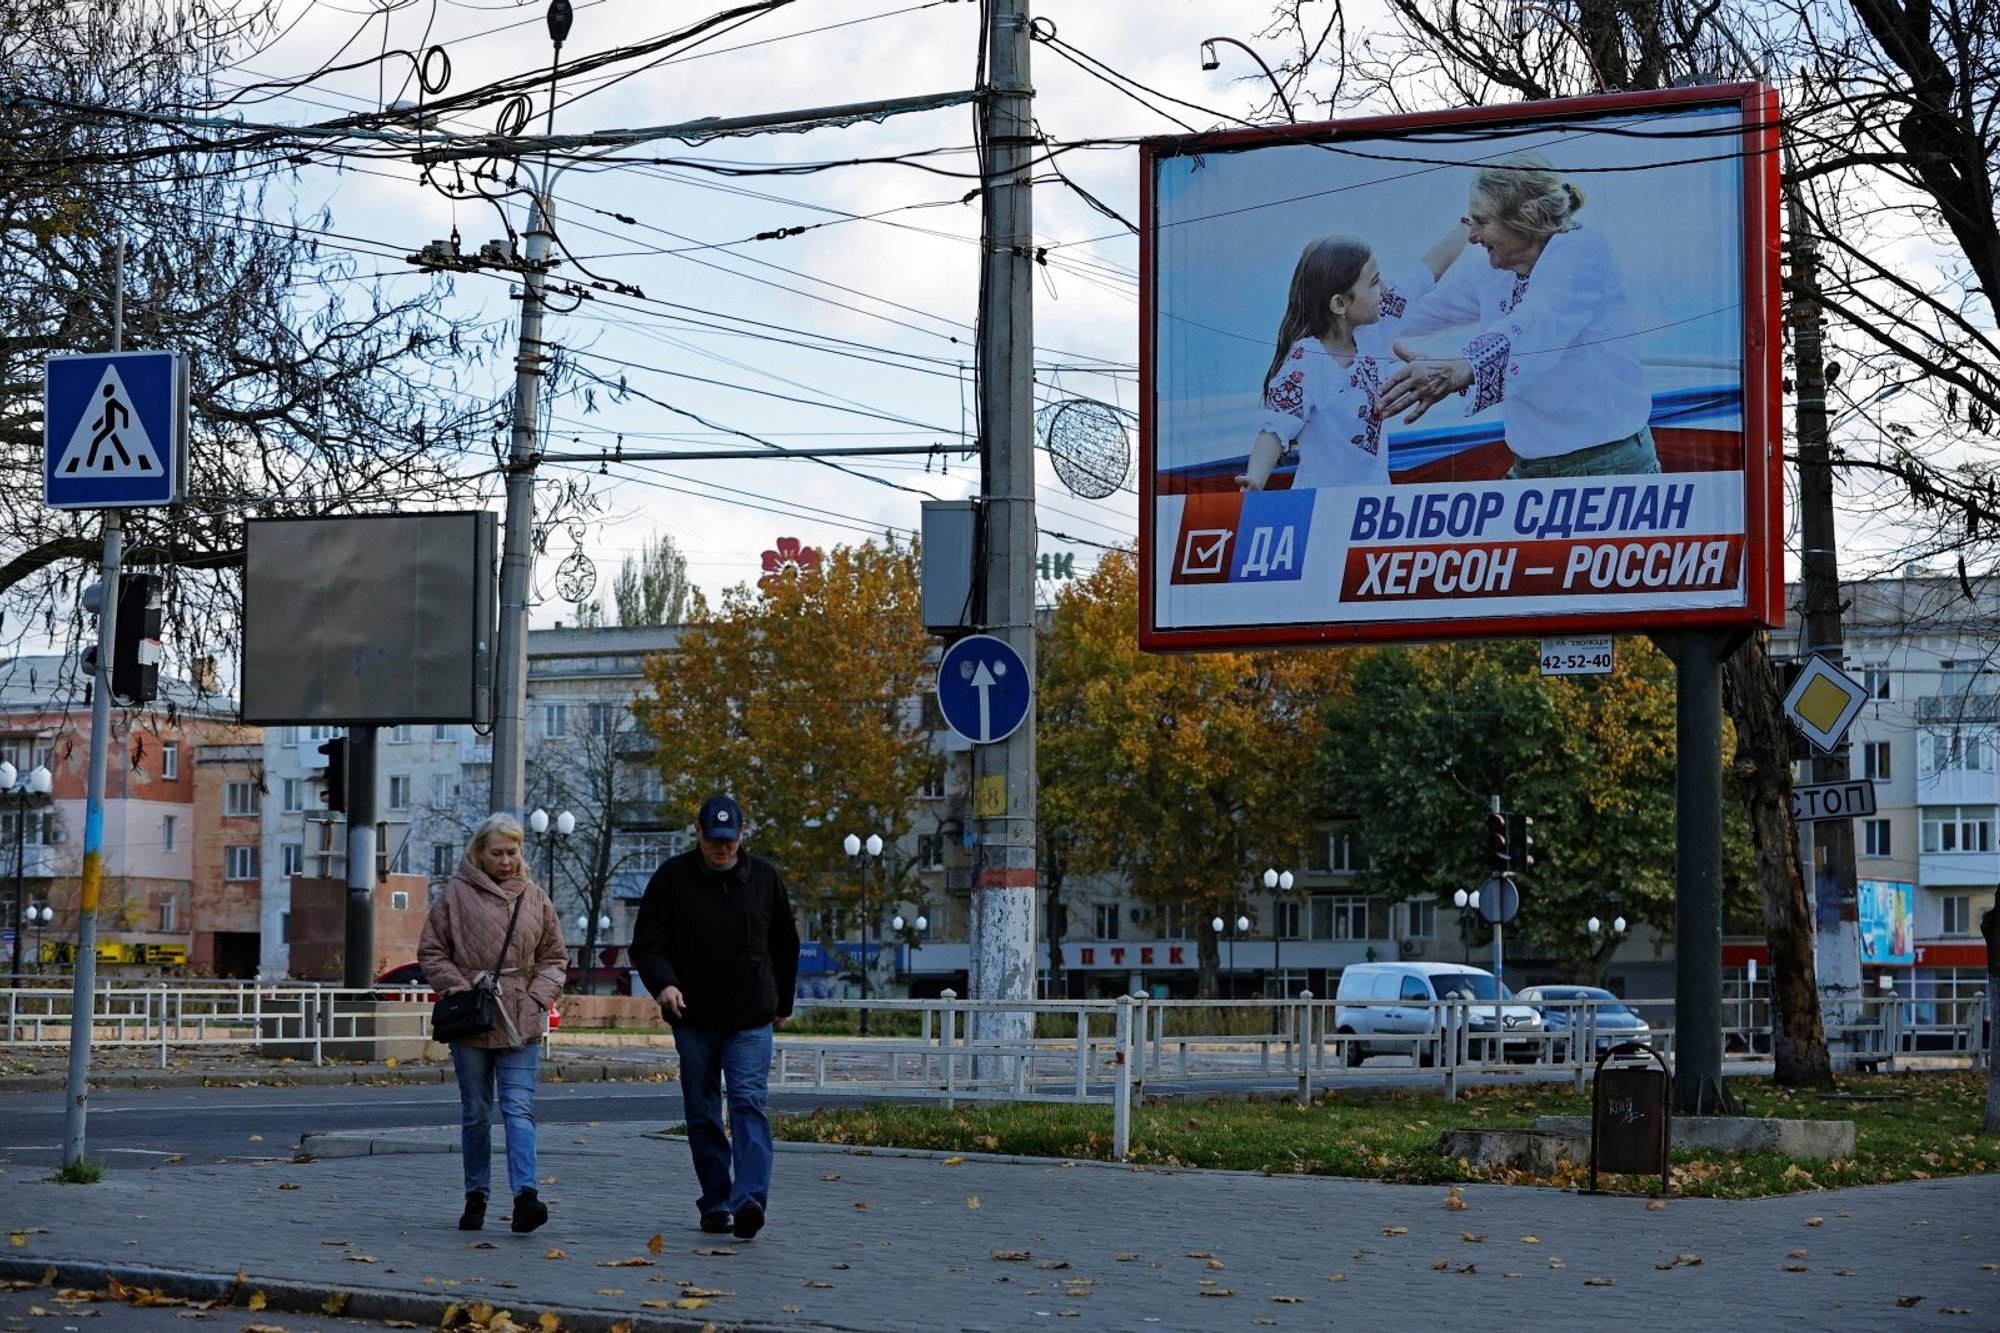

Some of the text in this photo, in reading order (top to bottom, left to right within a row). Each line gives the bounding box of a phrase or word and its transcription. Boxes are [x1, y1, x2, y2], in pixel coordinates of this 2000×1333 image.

[1349, 483, 1695, 541] ВЫБОР СДЕЛАН
[1240, 525, 1294, 577] ДА
[1357, 547, 1517, 596] ХЕРСОН
[1563, 540, 1729, 589] РОССИЯ
[1542, 653, 1611, 669] 42-52-40
